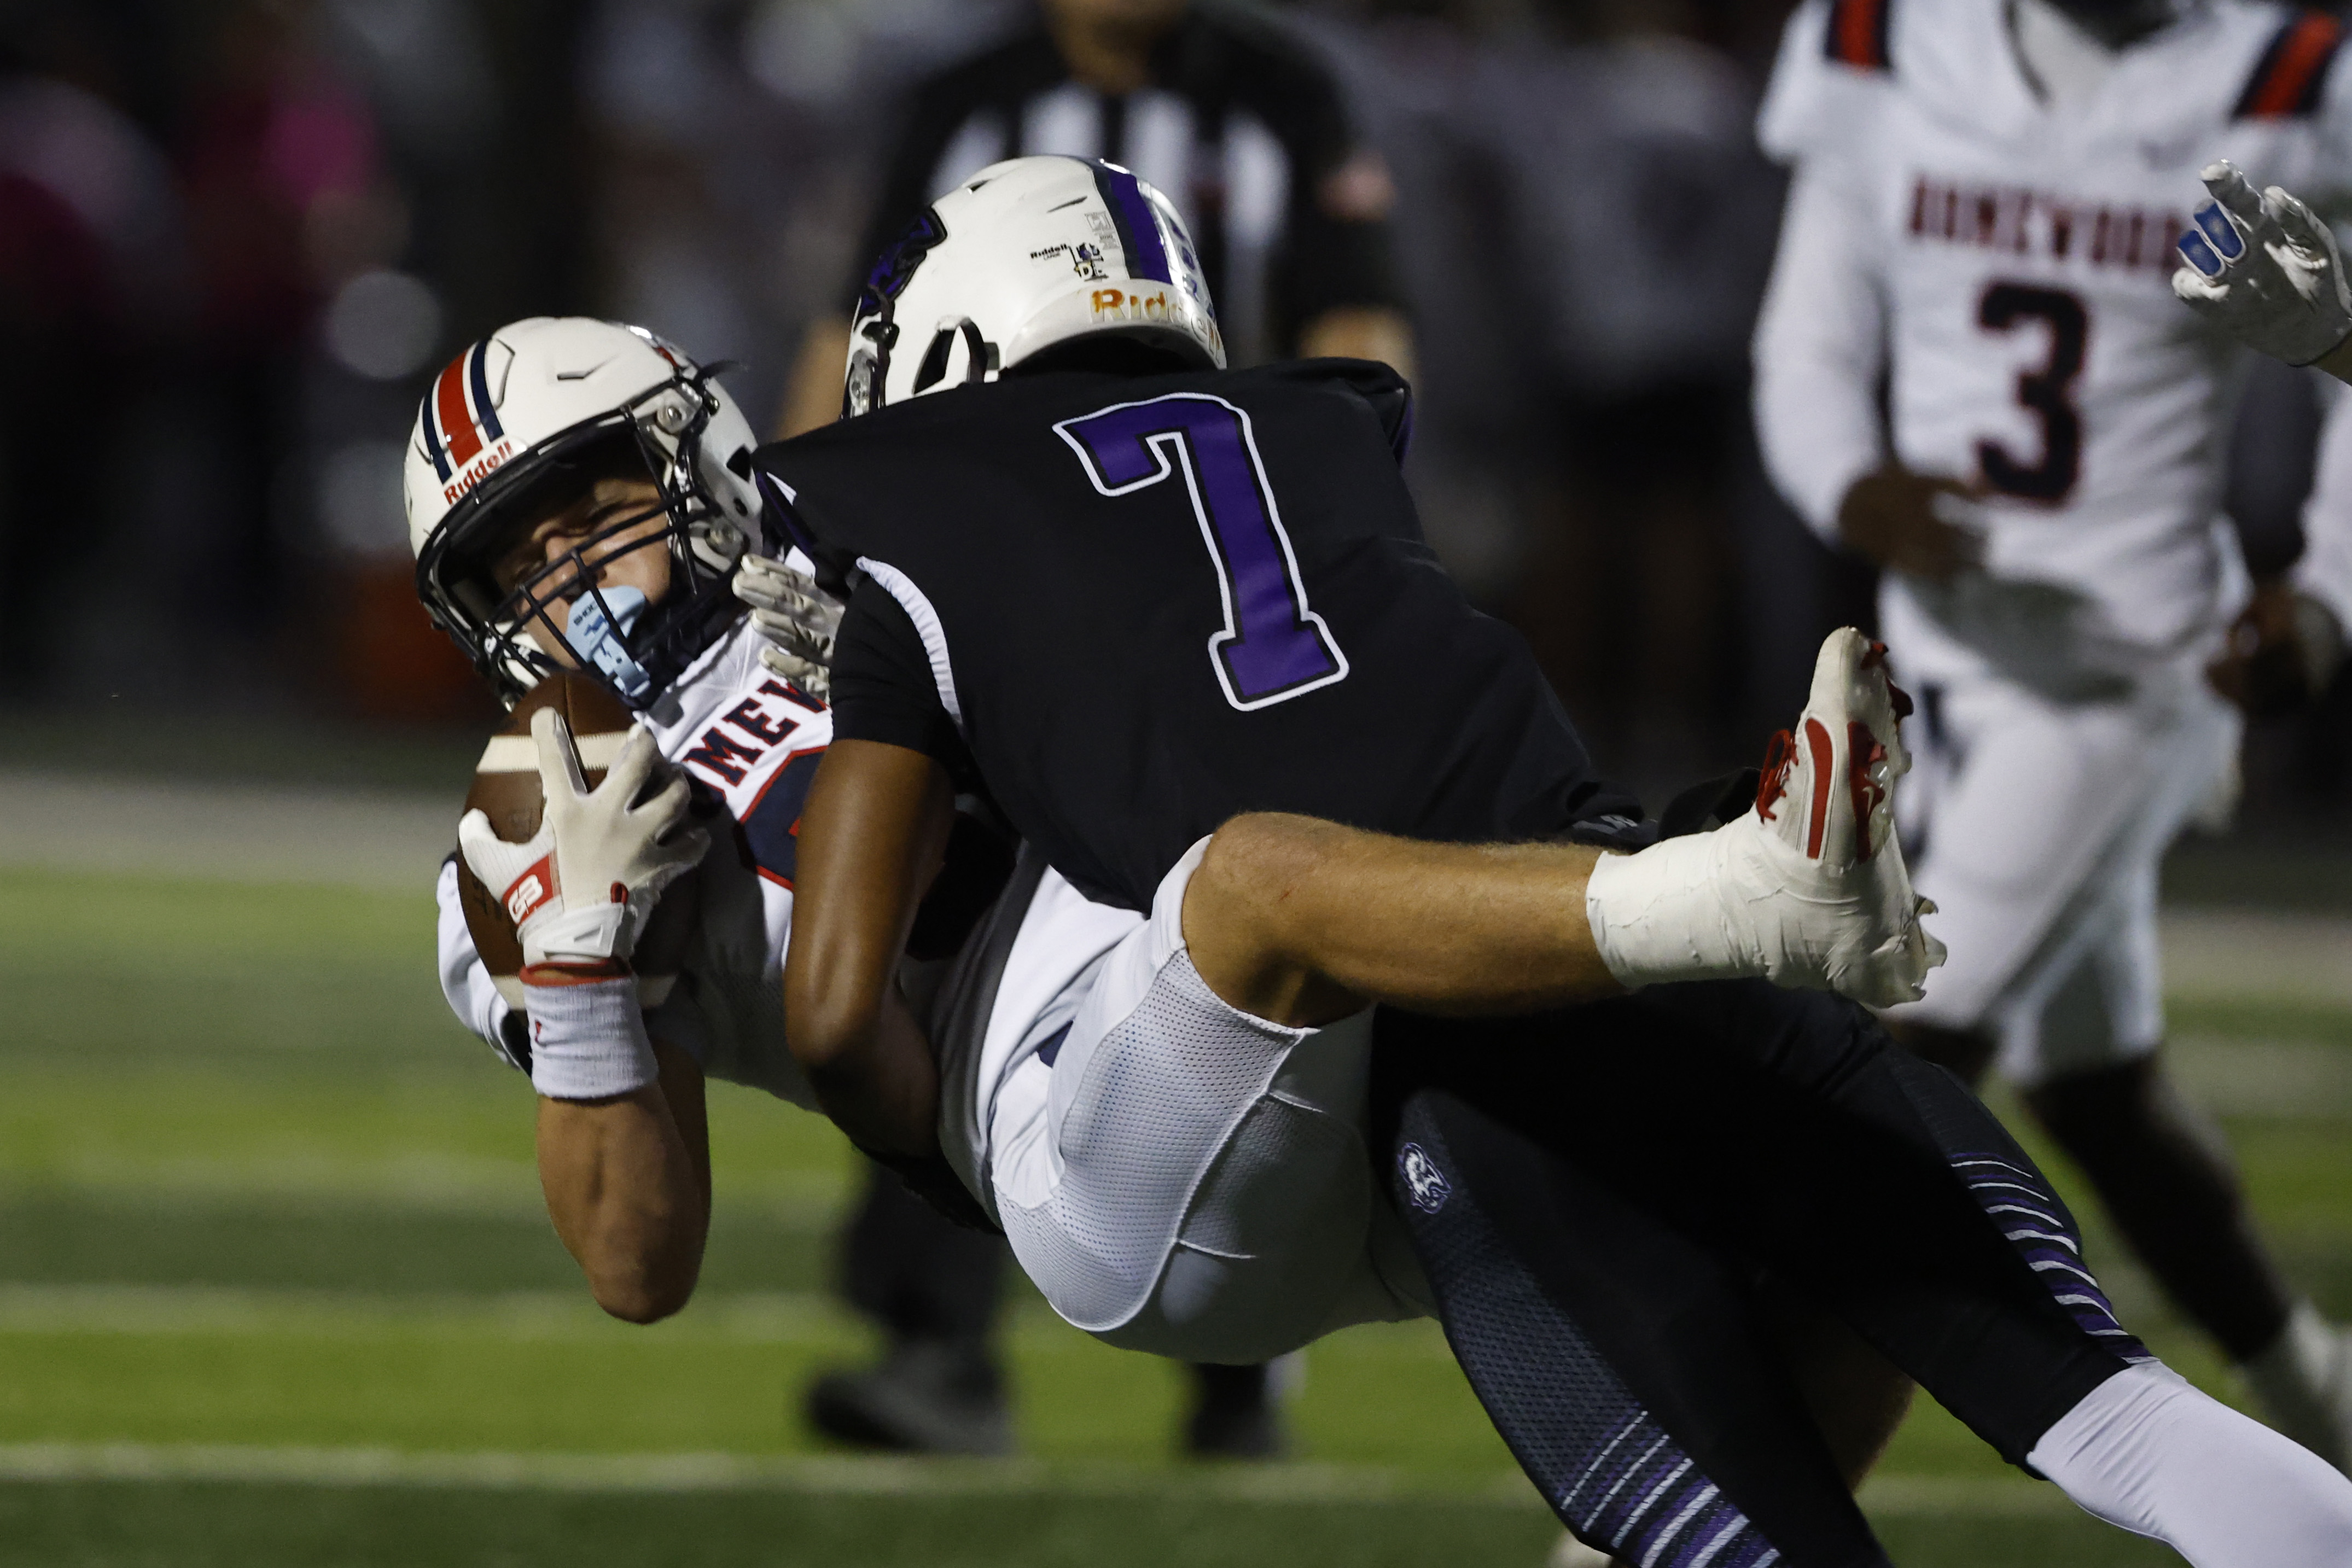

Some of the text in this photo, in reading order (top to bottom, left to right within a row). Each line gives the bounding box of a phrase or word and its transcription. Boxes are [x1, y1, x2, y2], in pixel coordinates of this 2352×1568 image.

[443, 440, 513, 505] Riddell
[1976, 278, 2089, 509] 3
[1052, 392, 1349, 712] 7
